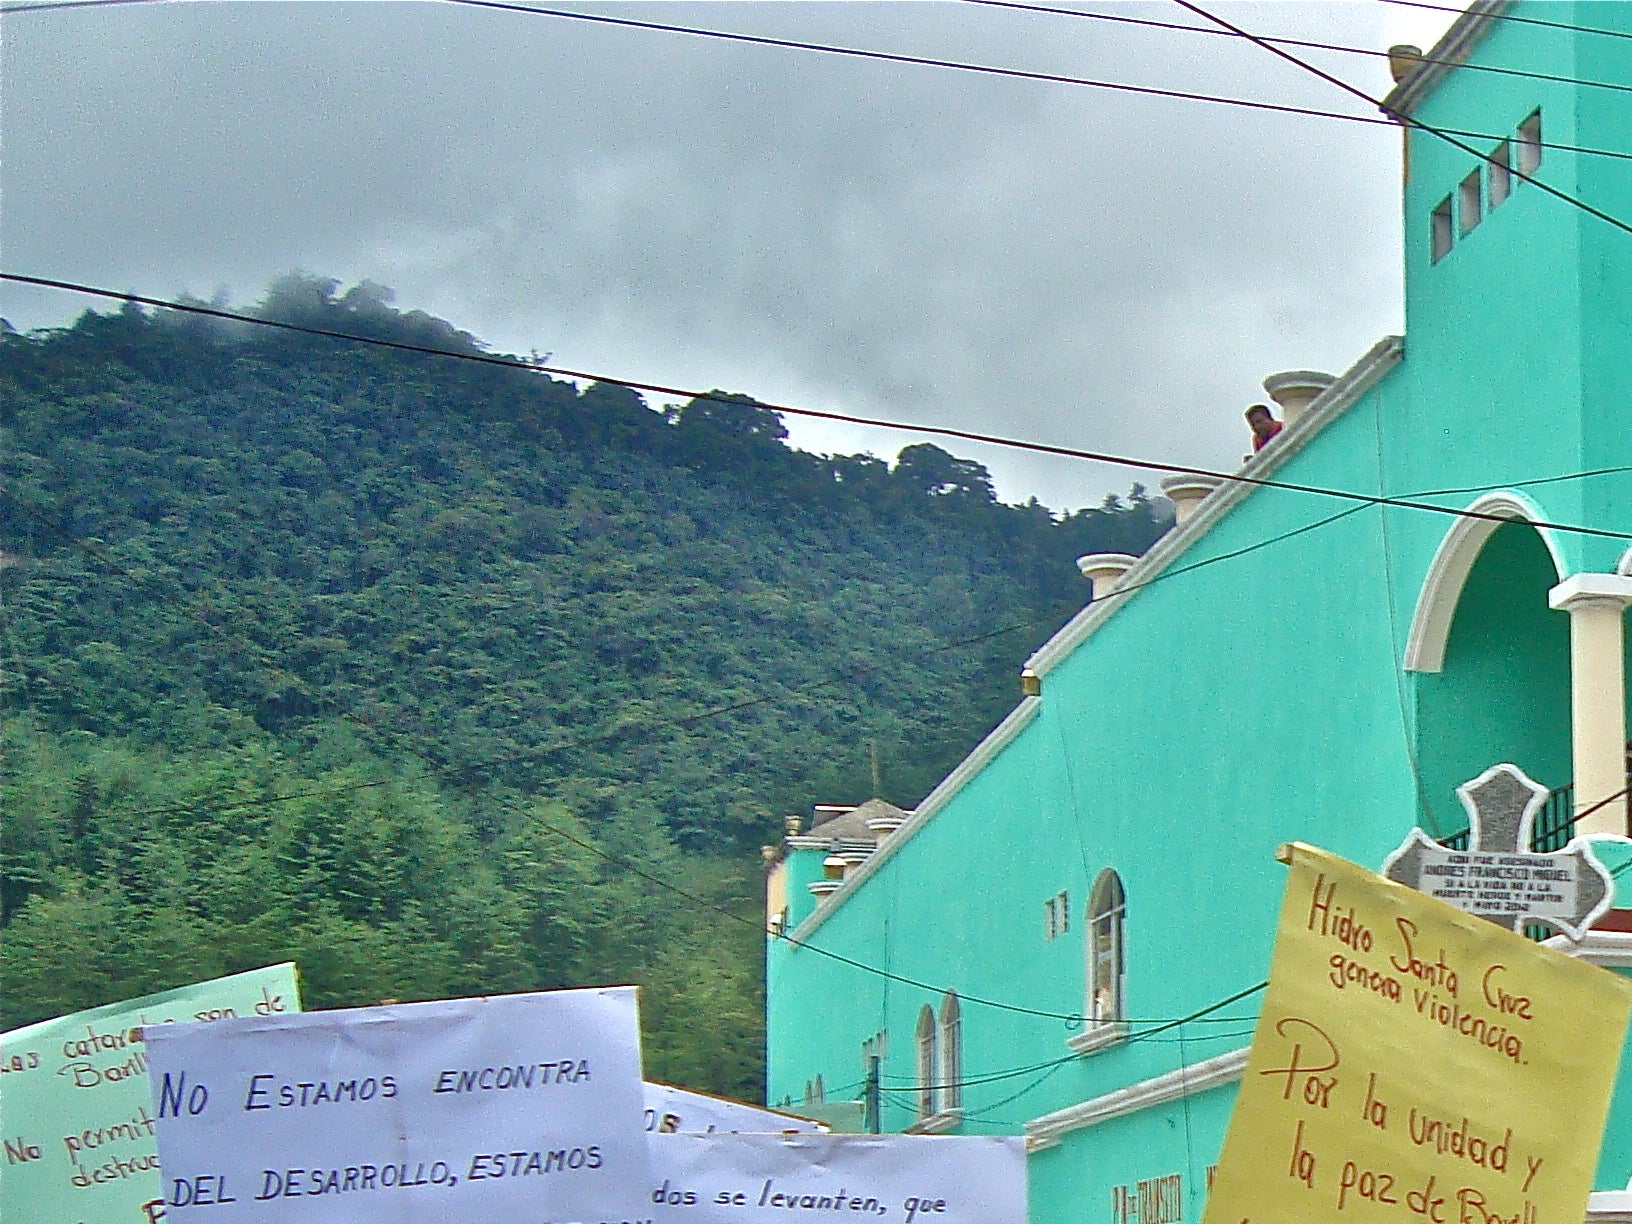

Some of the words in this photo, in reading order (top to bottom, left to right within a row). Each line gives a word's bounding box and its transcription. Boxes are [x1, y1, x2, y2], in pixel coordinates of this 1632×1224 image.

[1308, 873, 1375, 954] Hidro
[1391, 917, 1460, 997] Santa
[1483, 965, 1534, 1021] Cruz
[255, 987, 287, 1016] de
[434, 1059, 591, 1095] ENCONTRA
[1259, 1017, 1342, 1110] Por
[1363, 1073, 1388, 1130] la
[1521, 1153, 1545, 1193] y
[4, 1136, 43, 1165] No
[64, 1107, 156, 1165] permit
[71, 1155, 162, 1187] destruc
[168, 1175, 236, 1208] DEL
[255, 1159, 457, 1202] DESARROLLO,
[467, 1146, 603, 1181] ESTAMOS
[1289, 1121, 1313, 1188] la
[1338, 1160, 1397, 1210] paz
[1406, 1176, 1447, 1224] de
[651, 1178, 698, 1206] dos
[713, 1191, 747, 1207] se
[758, 1178, 887, 1216] levanten,
[904, 1197, 946, 1224] que
